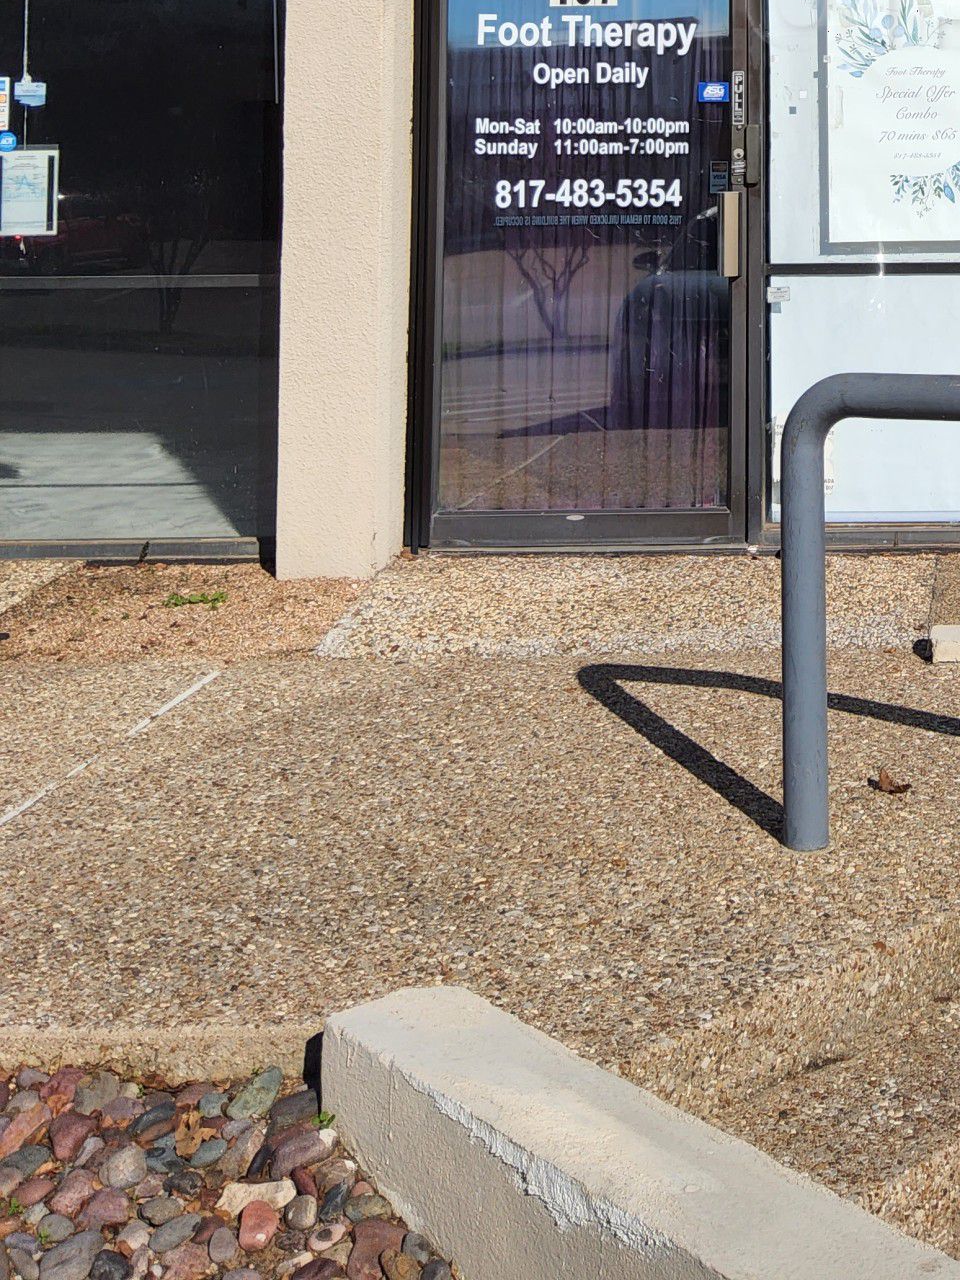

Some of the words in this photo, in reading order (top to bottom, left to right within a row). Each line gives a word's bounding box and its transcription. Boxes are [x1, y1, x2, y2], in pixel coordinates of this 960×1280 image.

[477, 14, 552, 46] Foot
[561, 15, 697, 55] Therapy
[533, 63, 589, 88] Open
[596, 62, 649, 88] Daily
[876, 85, 923, 103] Special
[926, 85, 955, 102] Offer
[896, 106, 938, 120] Combo
[475, 118, 541, 134] Mon-Sat
[553, 118, 690, 137] 10:00am-10:00pm
[879, 131, 896, 143] 70
[897, 131, 926, 141] mins
[474, 139, 538, 158] Sunday
[553, 139, 689, 157] 11:00am-7:00pm
[495, 179, 683, 208] 817-483-5354
